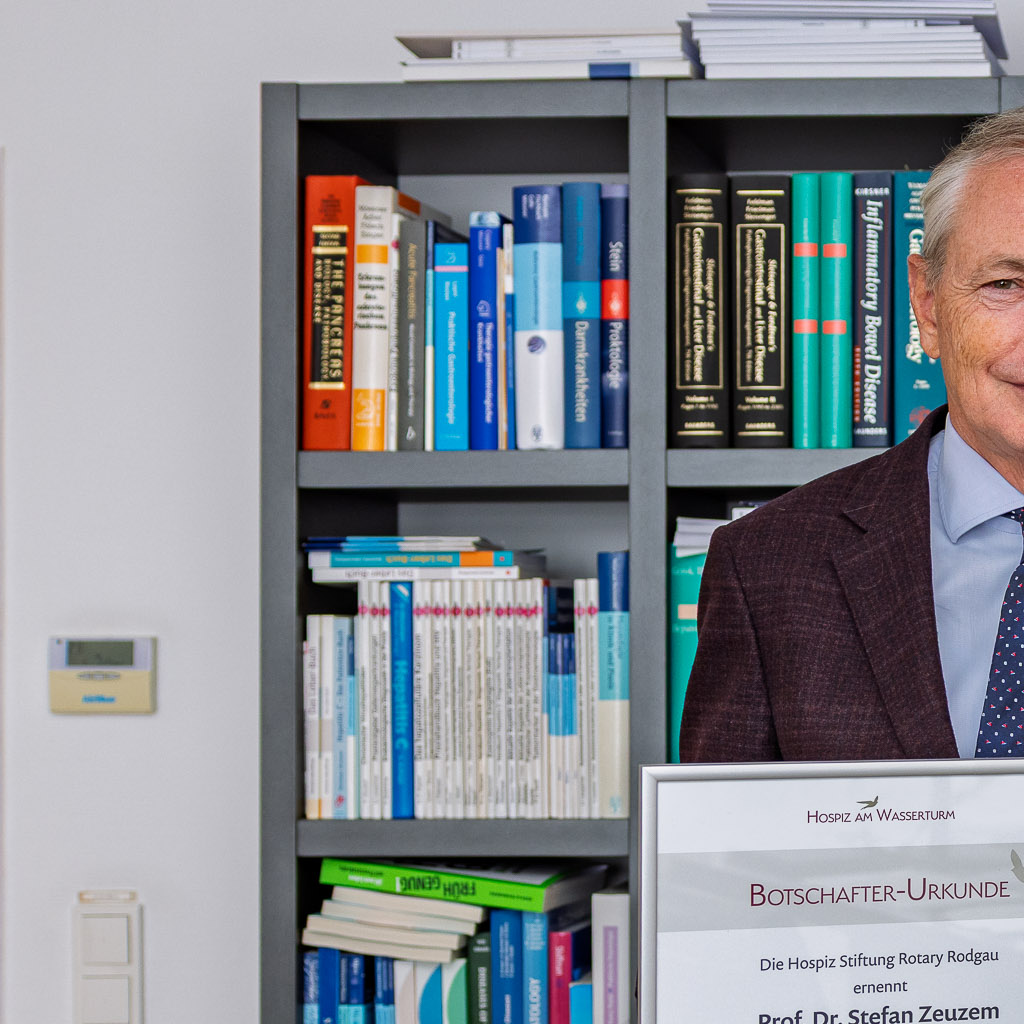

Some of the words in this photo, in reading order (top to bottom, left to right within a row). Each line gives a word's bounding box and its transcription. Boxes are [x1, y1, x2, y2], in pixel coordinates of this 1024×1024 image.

[855, 187, 889, 196] KIRSNER
[314, 259, 322, 279] AND
[408, 243, 418, 268] Acute
[608, 241, 624, 272] Stein
[693, 227, 705, 304] Gastrointestinal
[755, 229, 766, 305] Gastrointestinal
[860, 199, 883, 310] Inflammatory
[330, 259, 345, 289] THE
[313, 282, 322, 323] DISEASE
[407, 270, 418, 320] Pancreatitis
[755, 307, 763, 319] and
[328, 294, 344, 378] PANCREAS
[693, 319, 704, 343] Liver
[755, 320, 766, 344] Liver
[864, 315, 882, 361] Bowel
[606, 321, 624, 389] Proktologie
[693, 344, 705, 382] Disease
[755, 345, 766, 383] Disease
[574, 321, 590, 422] Darmkrankheiten
[863, 364, 881, 424] Disease
[392, 660, 408, 735] Hepatitis
[394, 737, 408, 750] C
[876, 808, 956, 821] WASSERTURM
[750, 877, 1010, 907] BOTSCHAFTER-URKUNDE
[760, 957, 784, 972] Die
[787, 954, 836, 973] Hospiz
[839, 951, 895, 969] Stiftung
[899, 950, 944, 968] Rotary
[947, 948, 999, 966] Rodgau
[853, 979, 908, 995] ernennt
[918, 1004, 1000, 1023] Zeuzem
